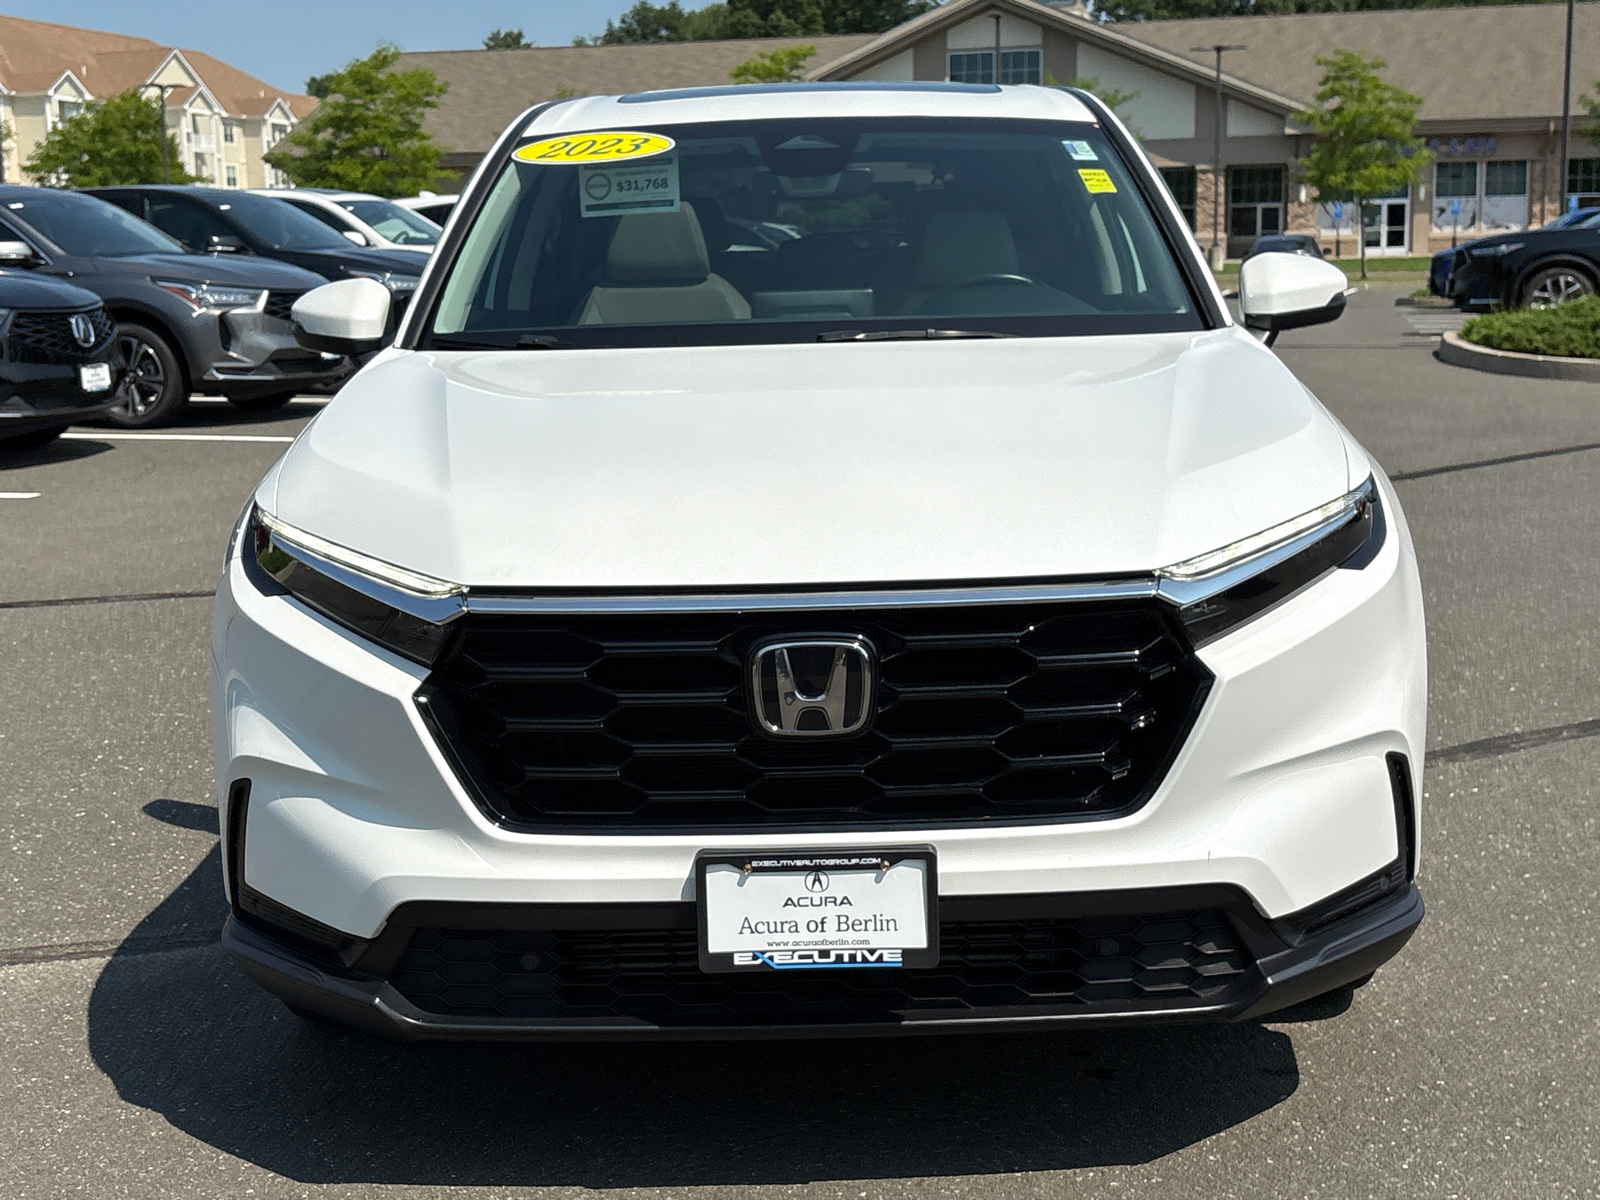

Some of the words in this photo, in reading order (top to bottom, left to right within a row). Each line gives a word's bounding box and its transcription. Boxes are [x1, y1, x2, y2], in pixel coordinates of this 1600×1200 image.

[535, 137, 651, 160] 2023
[616, 177, 669, 192] $31,768
[751, 857, 882, 868] EXECUTIVEAUTOGROUP.COM
[782, 896, 854, 908] ACURA
[738, 915, 800, 935] Acura
[806, 916, 827, 933] of
[836, 913, 899, 932] Berlin
[766, 937, 871, 948] www.acuraofberlin.com
[733, 949, 903, 968] EXECUTIVE
